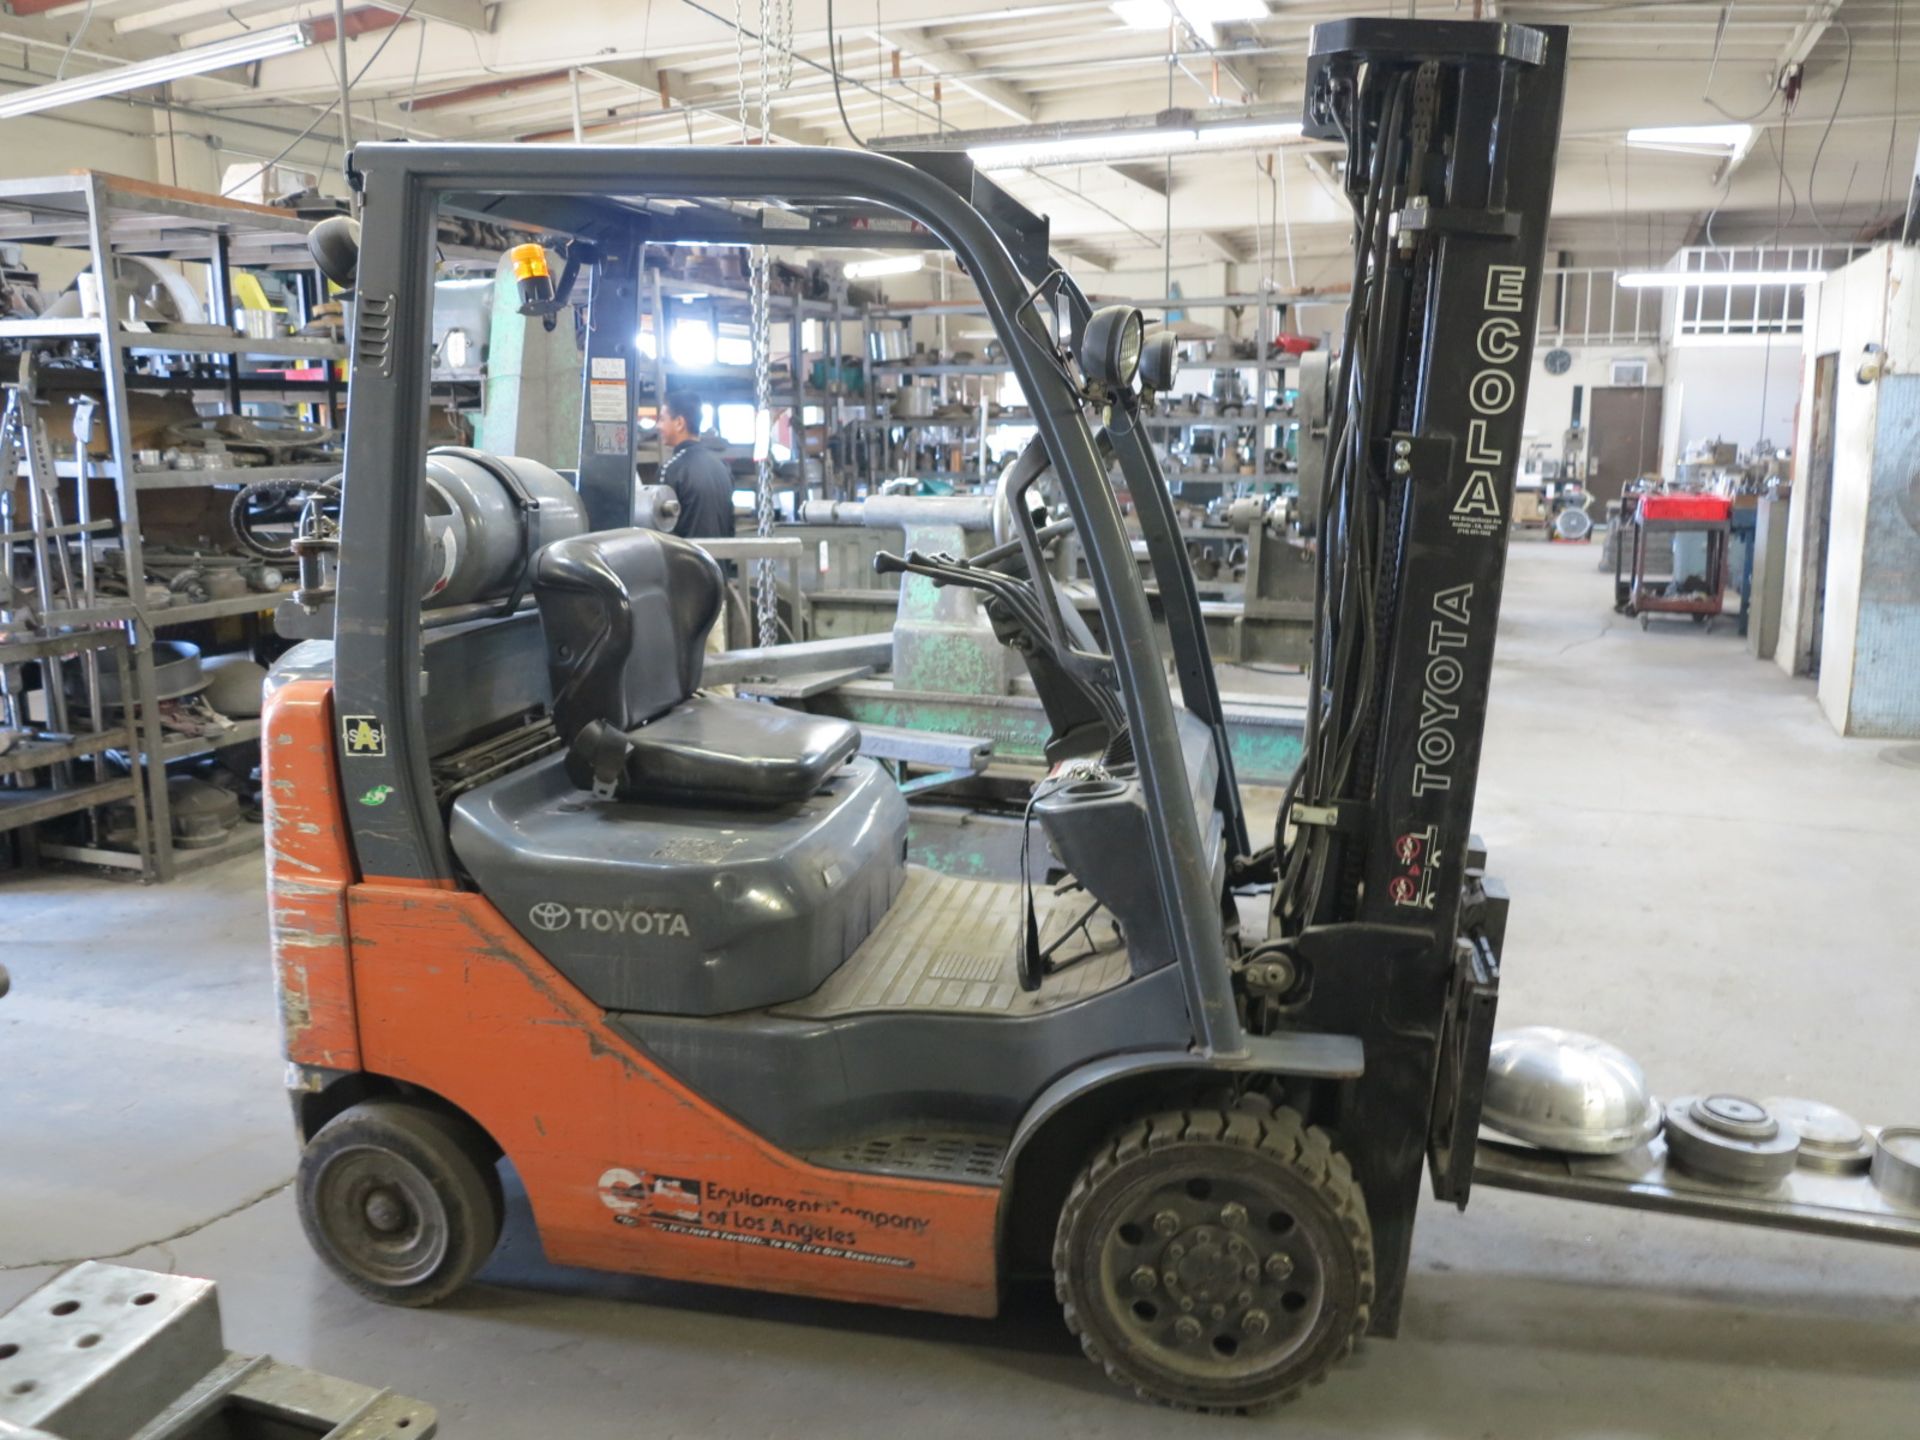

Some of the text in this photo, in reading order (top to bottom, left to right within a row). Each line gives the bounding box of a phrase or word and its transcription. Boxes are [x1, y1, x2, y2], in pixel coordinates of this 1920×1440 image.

[1453, 265, 1526, 516] ECOLA
[1412, 583, 1474, 797] TOYOTA
[574, 907, 691, 937] TOYOTA
[706, 1209, 856, 1245] of Los Angeles
